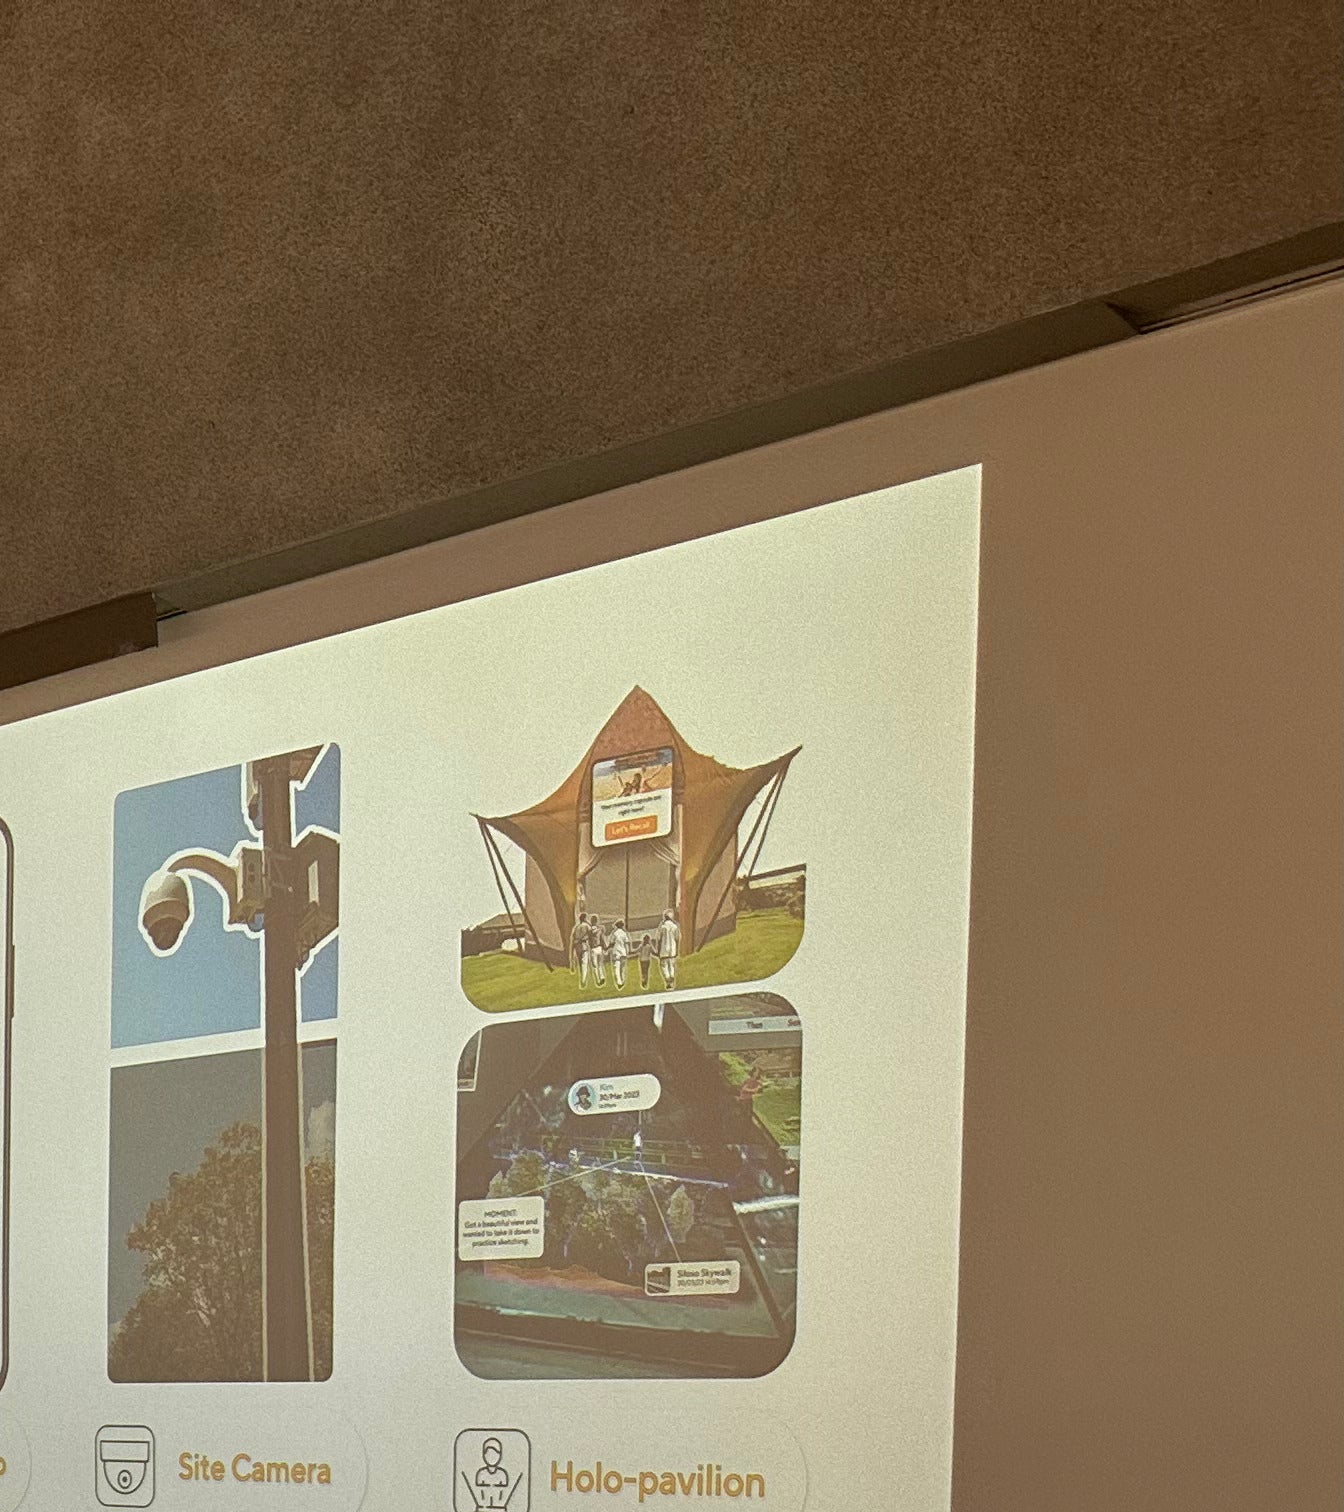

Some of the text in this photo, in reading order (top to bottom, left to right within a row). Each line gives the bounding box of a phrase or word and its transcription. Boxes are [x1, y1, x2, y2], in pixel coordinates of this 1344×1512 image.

[178, 1451, 332, 1484] Site Camera
[550, 1459, 766, 1503] Holo-pavilion
